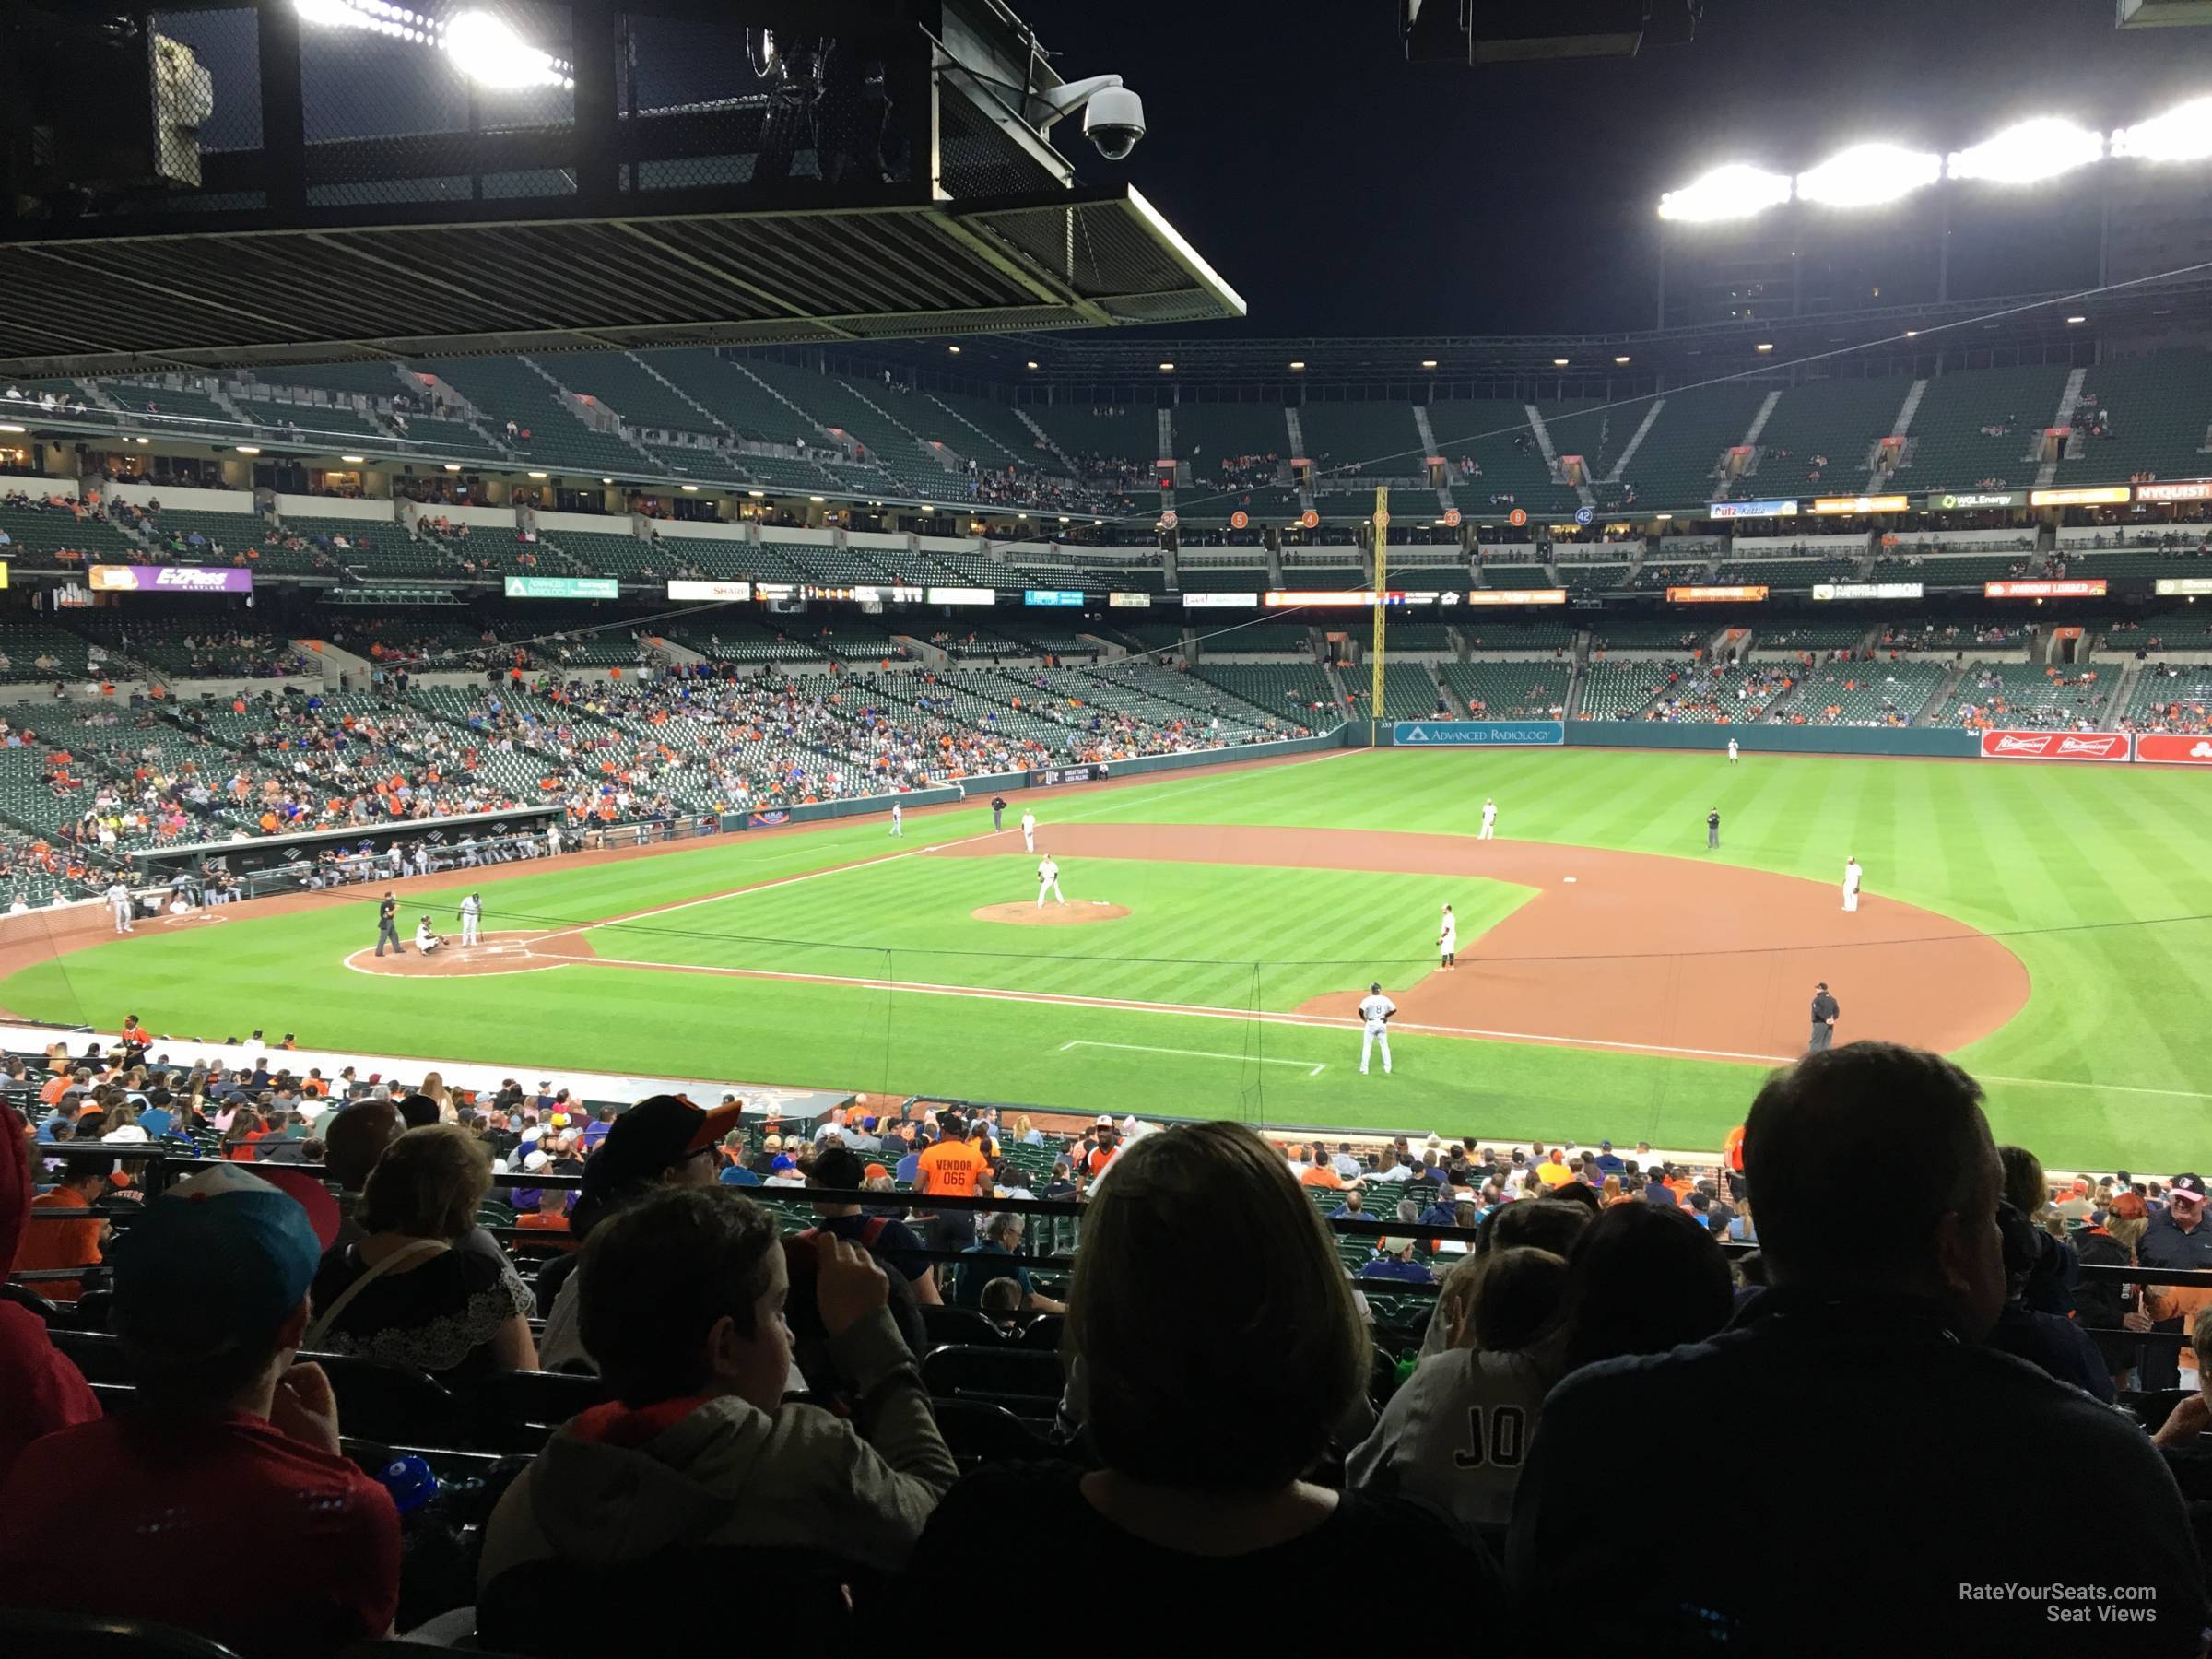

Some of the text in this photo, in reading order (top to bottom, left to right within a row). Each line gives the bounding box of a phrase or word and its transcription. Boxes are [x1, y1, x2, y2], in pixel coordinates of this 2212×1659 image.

[1979, 496, 2011, 504] Energy
[1236, 516, 1242, 524] 5
[1307, 515, 1312, 524] 4
[1448, 513, 1458, 523] 33
[1578, 512, 1590, 521] 42
[713, 586, 747, 595] SHARP
[1431, 730, 1550, 741] ADVANCED RADIOLOGY
[2001, 737, 2045, 748] Budweiser
[2063, 739, 2110, 750] Budweiser
[1046, 771, 1059, 784] Lite
[1376, 1005, 1382, 1014] 8
[936, 1159, 971, 1171] VENDOR
[944, 1171, 964, 1184] 066
